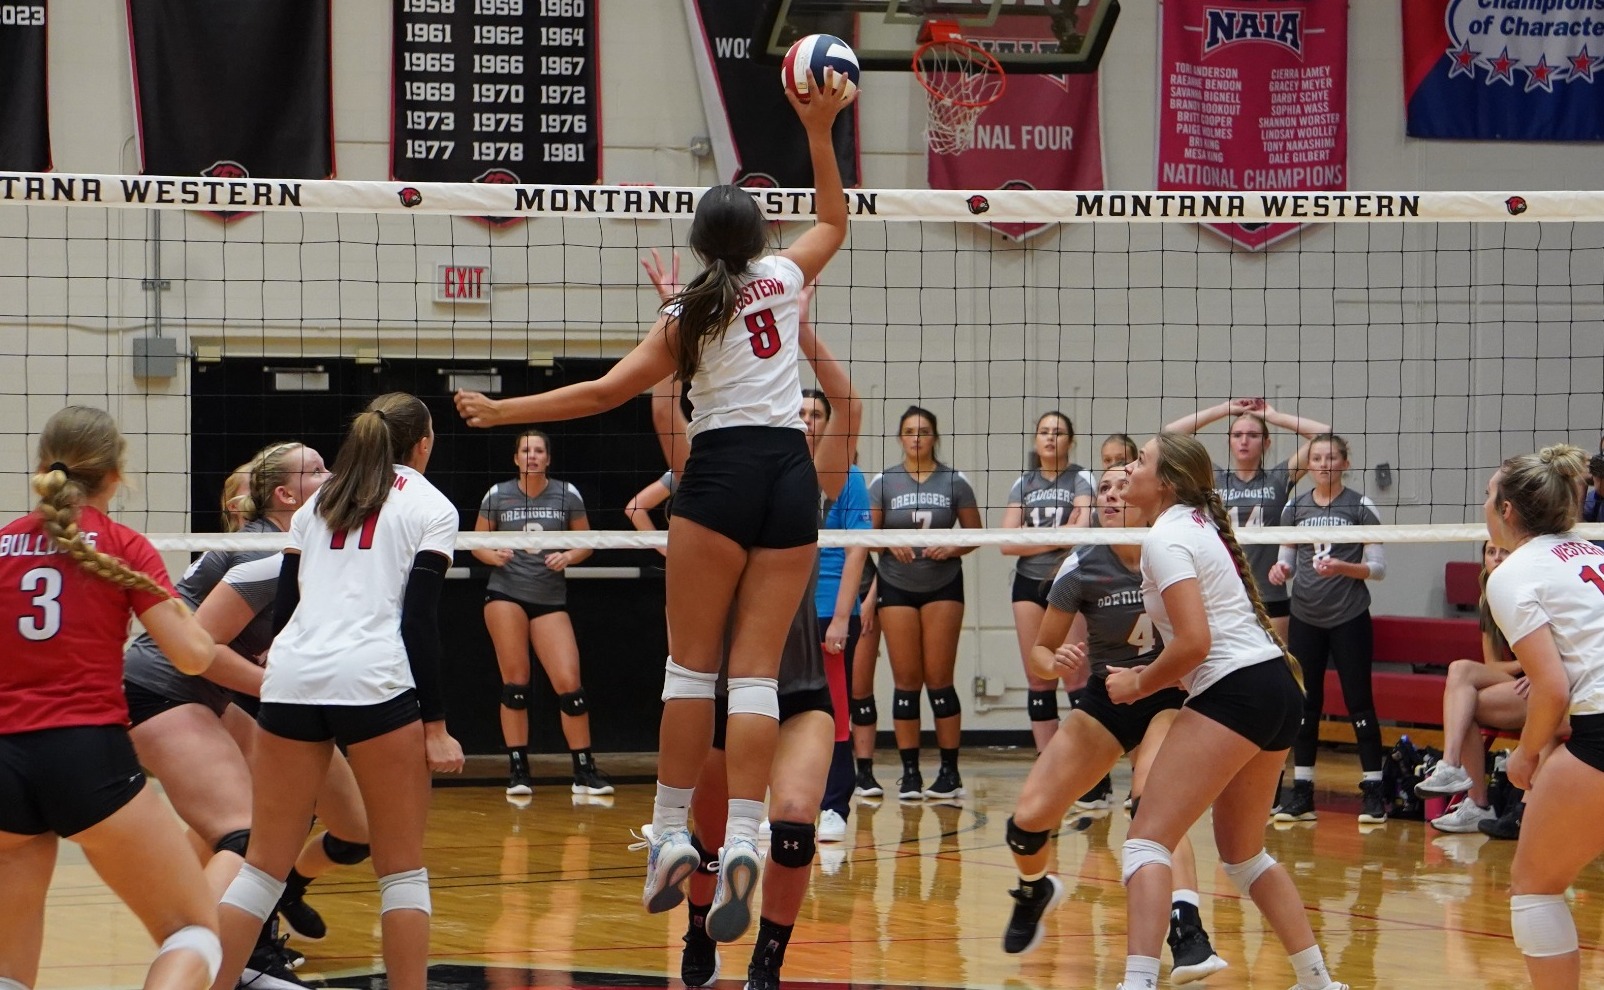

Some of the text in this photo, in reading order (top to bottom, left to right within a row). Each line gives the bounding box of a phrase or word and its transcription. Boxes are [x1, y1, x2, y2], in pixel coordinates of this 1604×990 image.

[0, 5, 45, 26] 023
[403, 0, 584, 17] 1958 1959 1960
[405, 23, 584, 46] 1961 1962 1964
[1205, 9, 1302, 51] NAIA
[1469, 16, 1494, 35] of
[404, 52, 585, 75] 1965 1966 1967
[1301, 66, 1330, 78] LAMEY
[404, 81, 586, 104] 1969 1970 1972
[1301, 78, 1332, 90] MEYER
[1204, 91, 1240, 103] BIGNELL
[1259, 113, 1339, 128] SHANNON WORSTER
[1271, 102, 1329, 116] SOPHIA WASS
[406, 110, 587, 133] 1973 1975 1976
[1022, 126, 1073, 149] FOUR
[1261, 128, 1295, 140] LINDSAY
[405, 139, 585, 162] 1977 1978 1981
[1263, 141, 1284, 152] TONY
[1269, 150, 1330, 164] DALE GILBERT
[1163, 162, 1342, 189] NATIONAL CHAMPIONS
[120, 179, 302, 207] WESTERN
[515, 188, 694, 213] MONTANA
[1075, 195, 1420, 217] MONTANA WESTERN
[444, 267, 484, 298] EXIT
[733, 278, 784, 313] ESTERN
[744, 308, 782, 359] 8
[1578, 563, 1604, 596] 1
[18, 566, 63, 642] 3
[1127, 612, 1157, 656] 4
